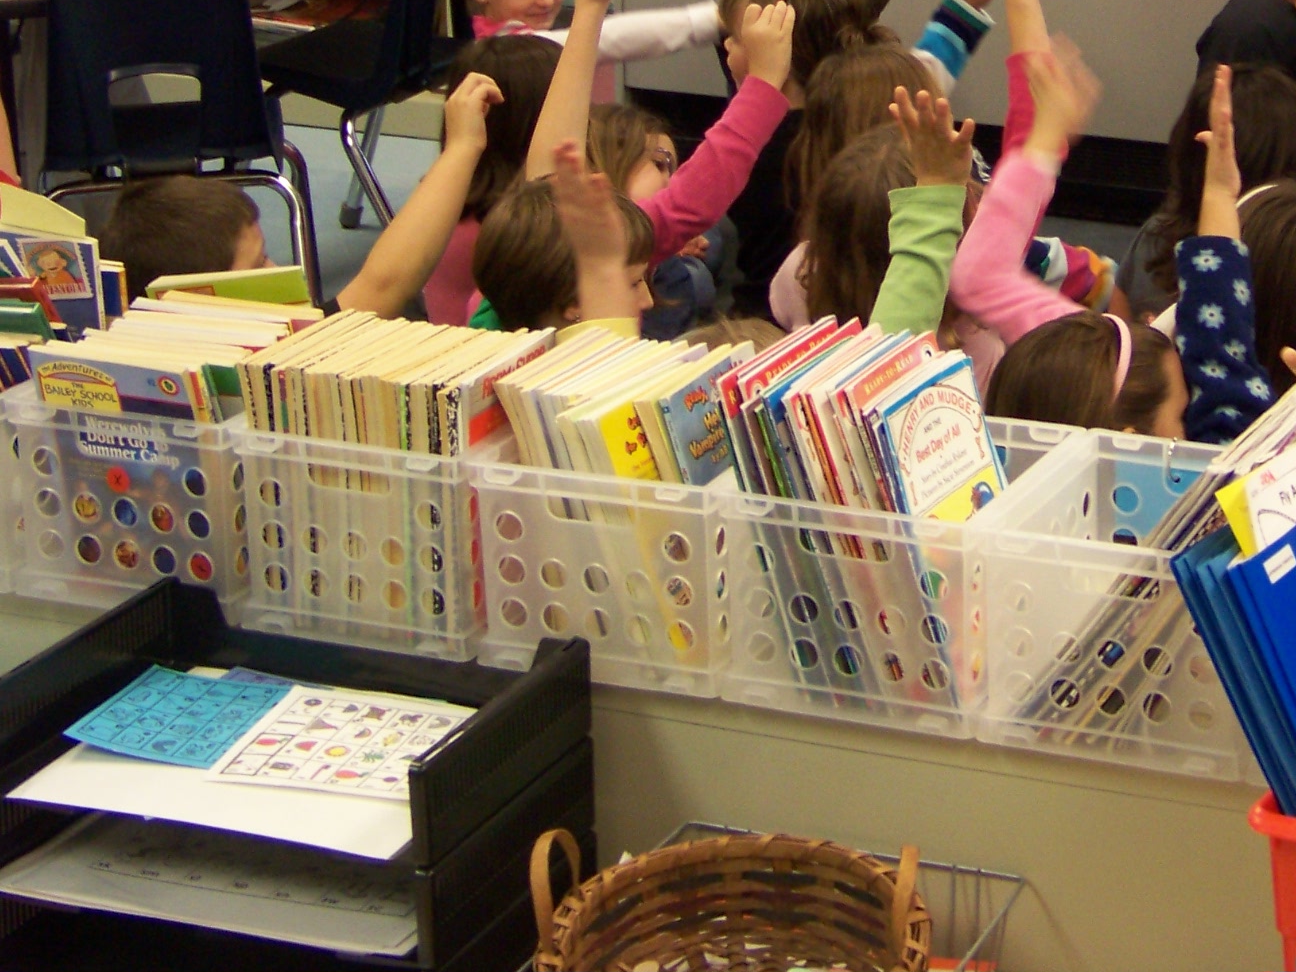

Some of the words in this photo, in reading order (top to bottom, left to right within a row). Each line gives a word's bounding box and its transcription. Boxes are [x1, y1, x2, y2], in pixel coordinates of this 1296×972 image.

[44, 385, 77, 397] BAILEY
[80, 390, 117, 403] SCHOOL
[72, 397, 94, 407] KIDS
[903, 409, 918, 454] HENRY
[919, 393, 935, 411] AND
[937, 391, 972, 414] MUDGE
[80, 440, 137, 460] Summer
[916, 449, 932, 463] Best
[931, 438, 944, 452] Day
[944, 430, 951, 444] of
[952, 424, 961, 439] All
[1279, 490, 1292, 506] Fly
